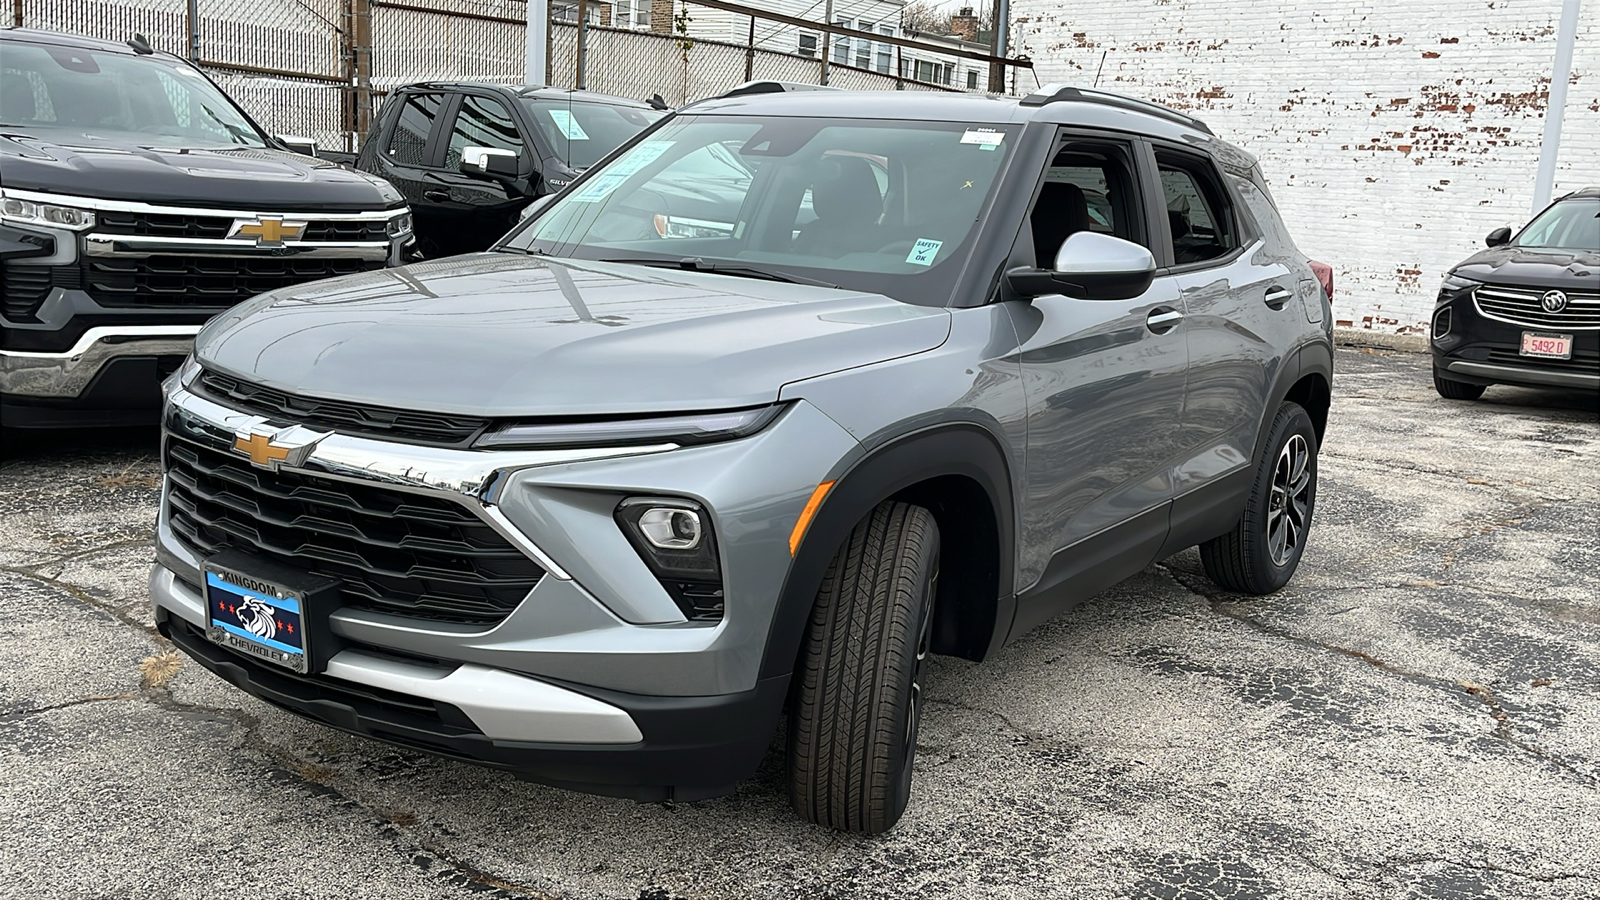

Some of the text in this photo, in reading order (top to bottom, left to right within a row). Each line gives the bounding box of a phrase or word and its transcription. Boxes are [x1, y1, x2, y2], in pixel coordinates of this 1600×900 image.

[916, 240, 940, 249] SAFETY
[1531, 340, 1555, 353] 5492
[222, 571, 277, 598] KINGDOM
[229, 637, 284, 662] CHEVROLET
